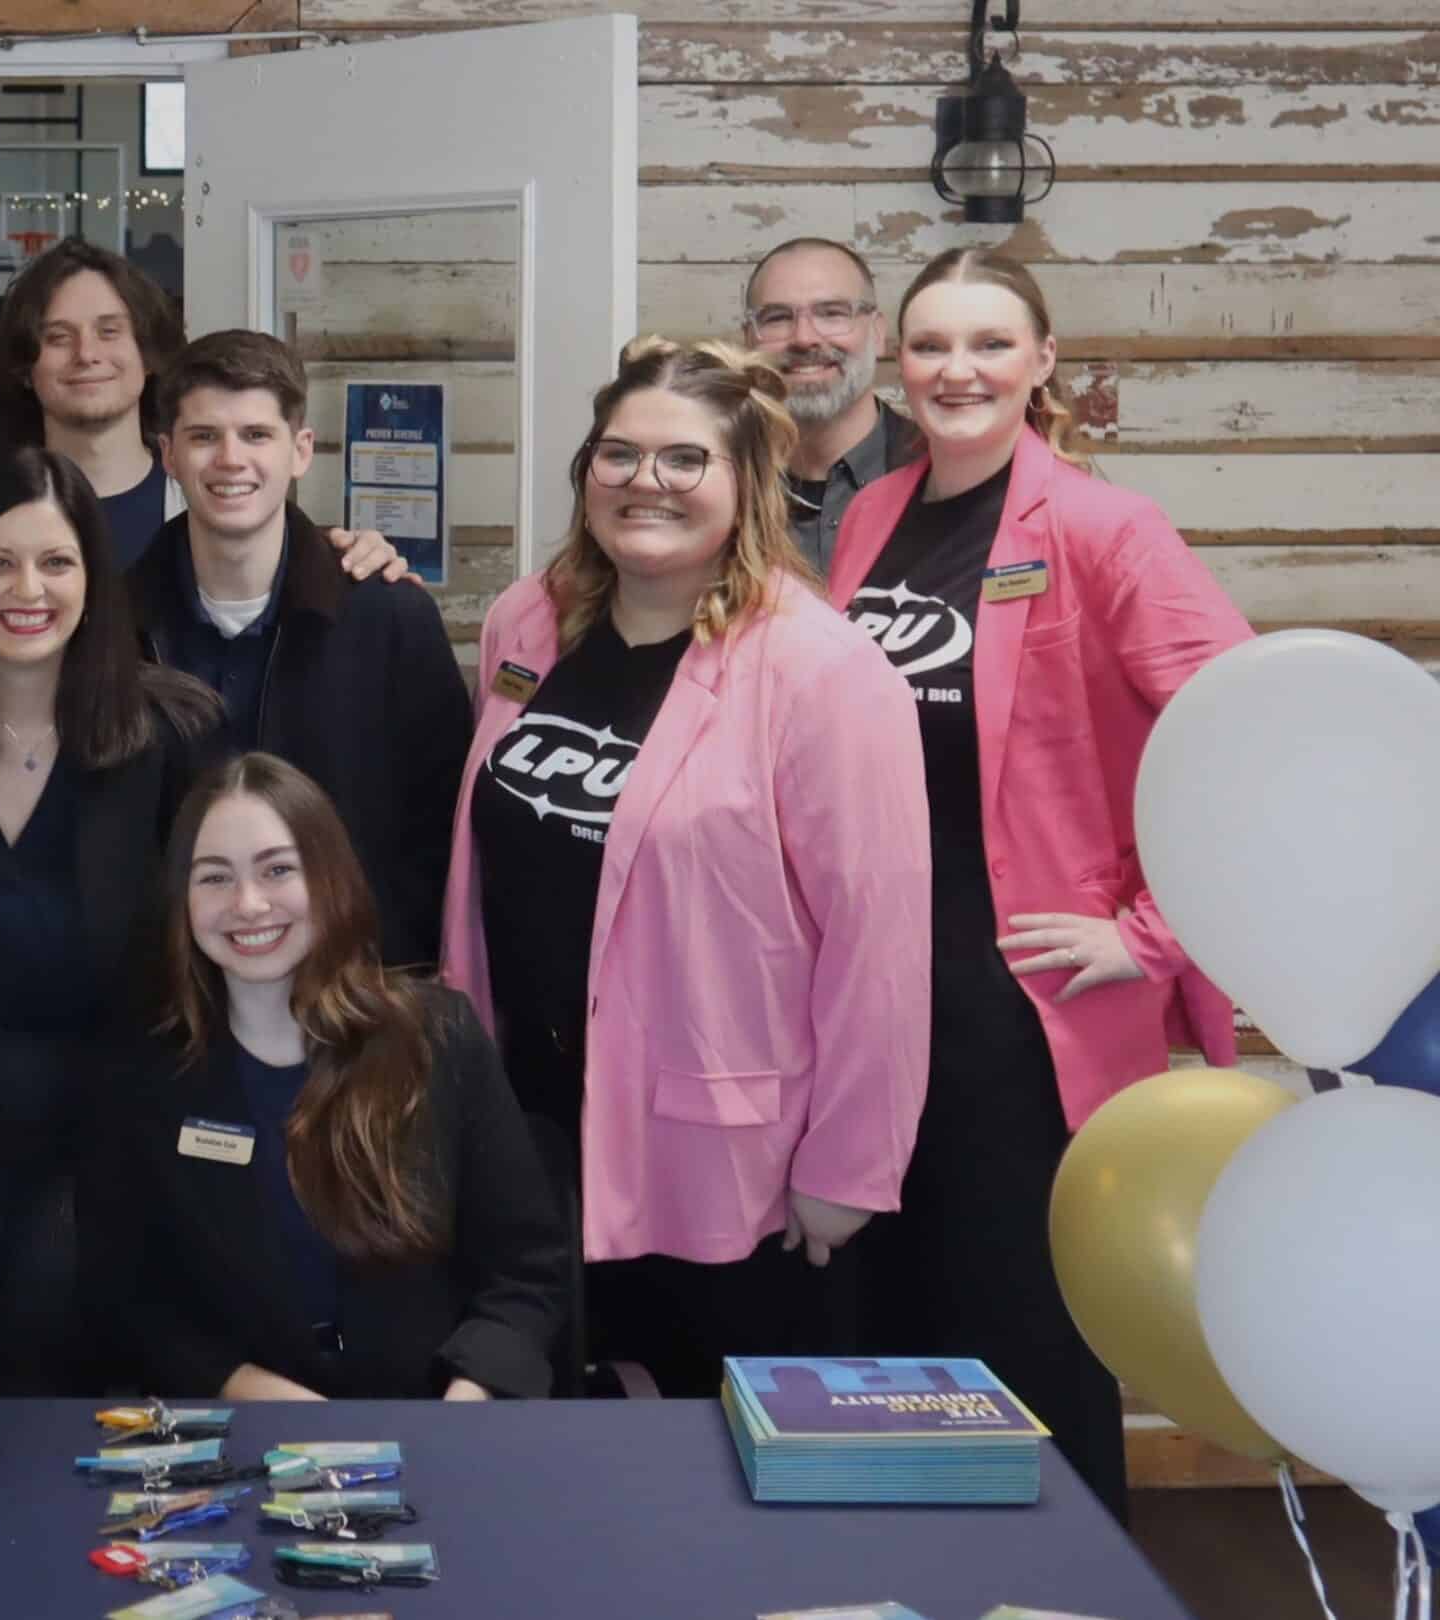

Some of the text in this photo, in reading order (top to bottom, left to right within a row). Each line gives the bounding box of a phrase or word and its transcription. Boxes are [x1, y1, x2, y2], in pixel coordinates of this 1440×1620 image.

[927, 687, 963, 702] BIG
[498, 733, 634, 798] LPU
[831, 1392, 989, 1406] UNIVERSITY
